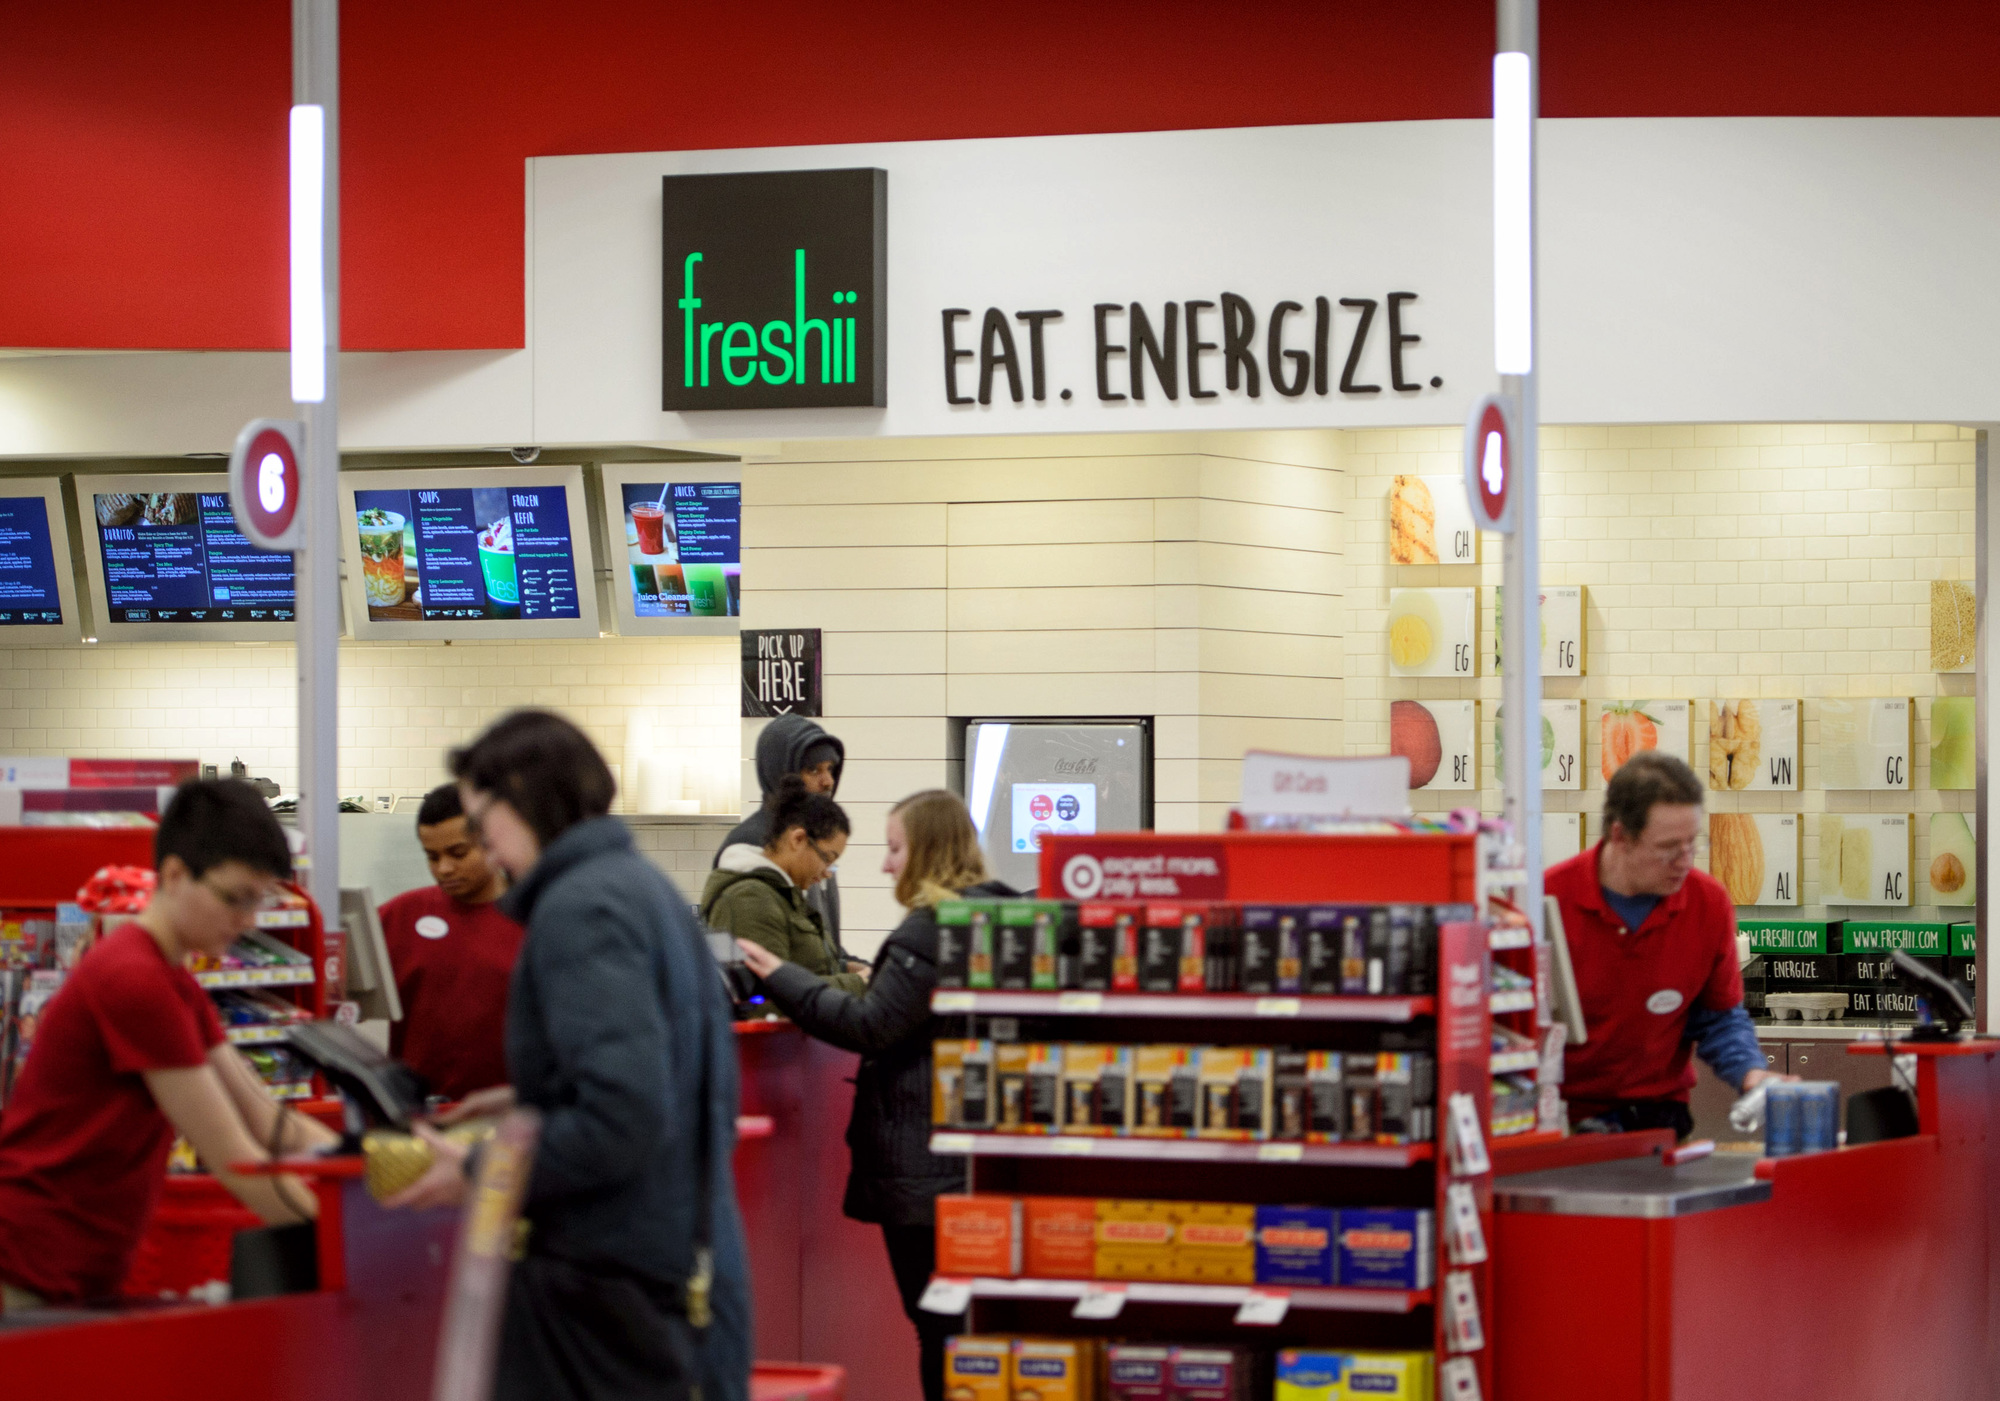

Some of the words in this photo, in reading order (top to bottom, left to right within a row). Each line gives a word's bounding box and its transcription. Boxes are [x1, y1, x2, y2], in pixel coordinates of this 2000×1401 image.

[678, 249, 857, 388] freshii
[942, 306, 1073, 405] EAT.
[1094, 292, 1443, 400] ENERGIZE.
[1482, 430, 1503, 495] 4
[257, 453, 286, 513] 6
[674, 486, 696, 497] JUICES
[202, 495, 224, 507] BOWLS
[418, 491, 440, 503] SOUPS
[512, 494, 539, 507] FROZEN
[514, 511, 535, 524] KEFIR
[104, 528, 135, 541] BURRITOS
[1455, 530, 1469, 558] CH
[638, 593, 657, 601] Juice
[658, 592, 695, 601] Cleanses
[758, 635, 784, 658] PICK
[790, 634, 804, 658] UP
[1455, 644, 1469, 671] EG
[1559, 640, 1574, 669] FG
[758, 659, 806, 702] HERE
[1454, 754, 1468, 782] BE
[1559, 754, 1574, 782] SP
[1770, 756, 1792, 785] WN
[1886, 756, 1903, 784] GC
[1102, 855, 1164, 877] expect
[1102, 876, 1135, 898] pay
[1776, 872, 1791, 900] AL
[1884, 872, 1902, 900] AC
[1740, 929, 1817, 948] W.FRESHII.COM
[1853, 929, 1938, 949] WWW.FRESHII.COM
[1774, 960, 1819, 978] ENERGIZE.
[1858, 962, 1878, 979] EAT.
[1854, 993, 1873, 1011] EAT.
[1876, 993, 1919, 1012] ENERGIZE
